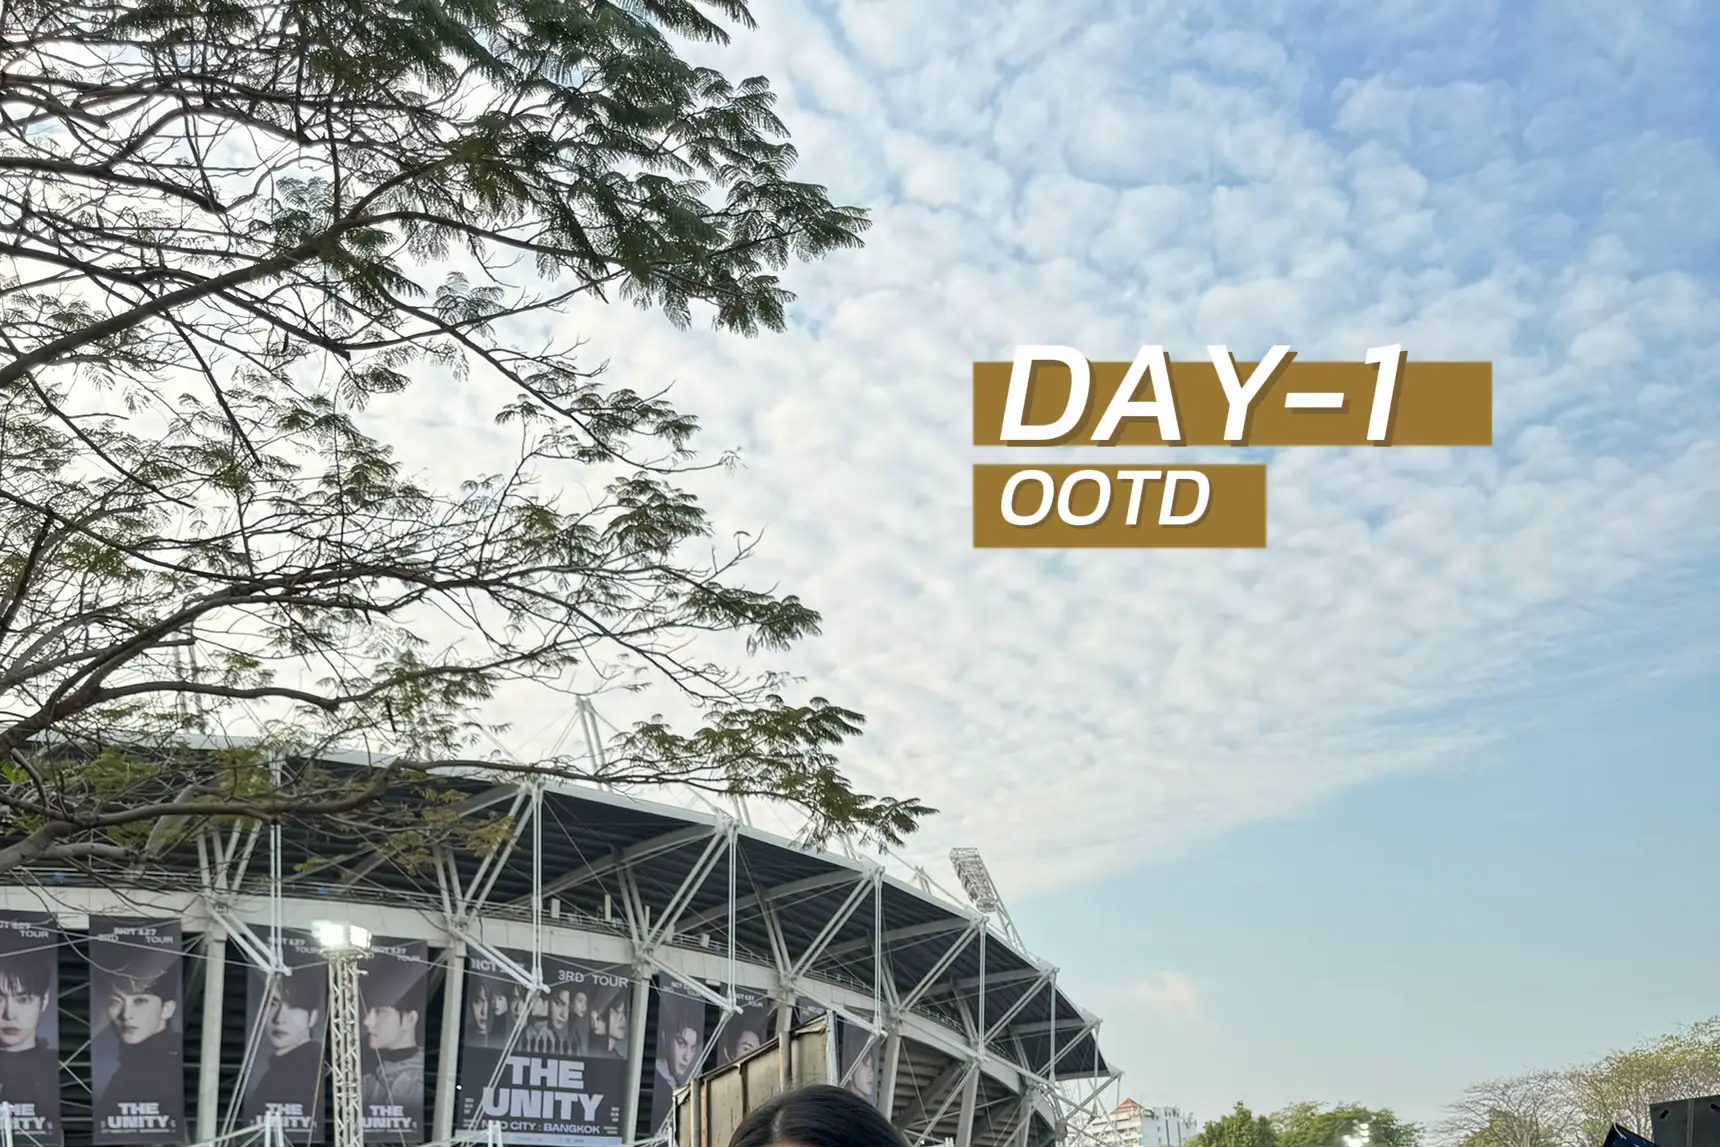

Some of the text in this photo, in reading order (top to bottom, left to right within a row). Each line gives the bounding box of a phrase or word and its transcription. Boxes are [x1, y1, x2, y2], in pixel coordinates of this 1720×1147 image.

[20, 930, 50, 939] TOUR
[145, 935, 174, 944] TOUR
[558, 969, 630, 989] 3RD TOUR
[506, 1055, 585, 1090] THE
[118, 1102, 160, 1116] THE
[265, 1103, 303, 1116] THE
[369, 1105, 404, 1117] THE
[481, 1086, 604, 1122] UNITY
[107, 1115, 170, 1129] UNITY
[362, 1116, 413, 1130] UNITY
[510, 1121, 537, 1132] CITY
[543, 1123, 601, 1135] BANGKOK
